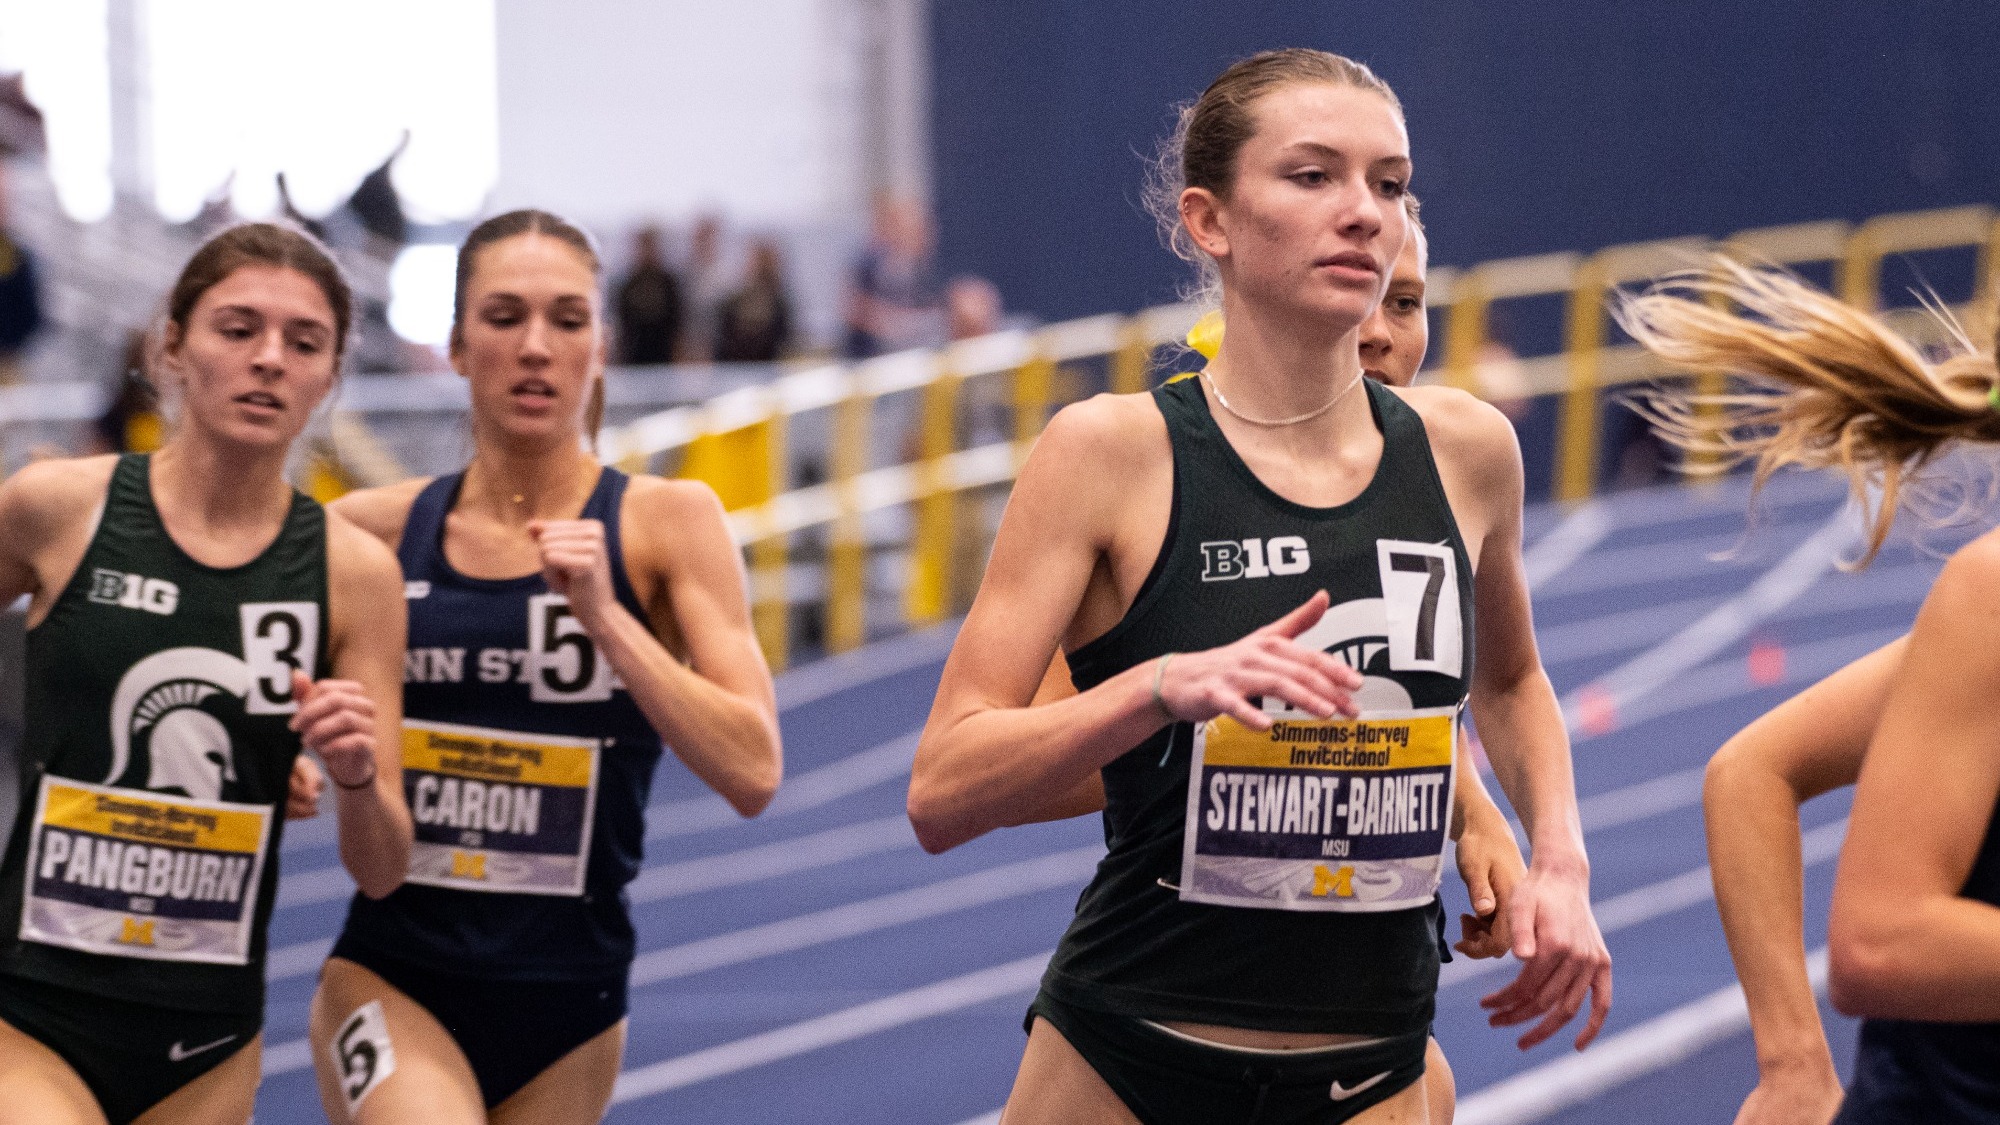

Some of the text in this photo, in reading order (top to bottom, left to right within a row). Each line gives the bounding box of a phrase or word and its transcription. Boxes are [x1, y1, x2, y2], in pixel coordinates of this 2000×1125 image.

[1389, 552, 1446, 661] 7
[256, 611, 304, 704] 3
[406, 647, 467, 683] NN
[541, 604, 596, 692] 5
[1271, 721, 1410, 747] Simmons-Harvey
[1290, 746, 1391, 767] Invitational
[414, 775, 541, 836] CARON
[1207, 772, 1444, 836] STEWART-BARNETT
[40, 830, 249, 903] PANGBURN
[1321, 839, 1351, 858] MSU
[1312, 865, 1355, 897] M
[338, 1014, 378, 1101] 5
